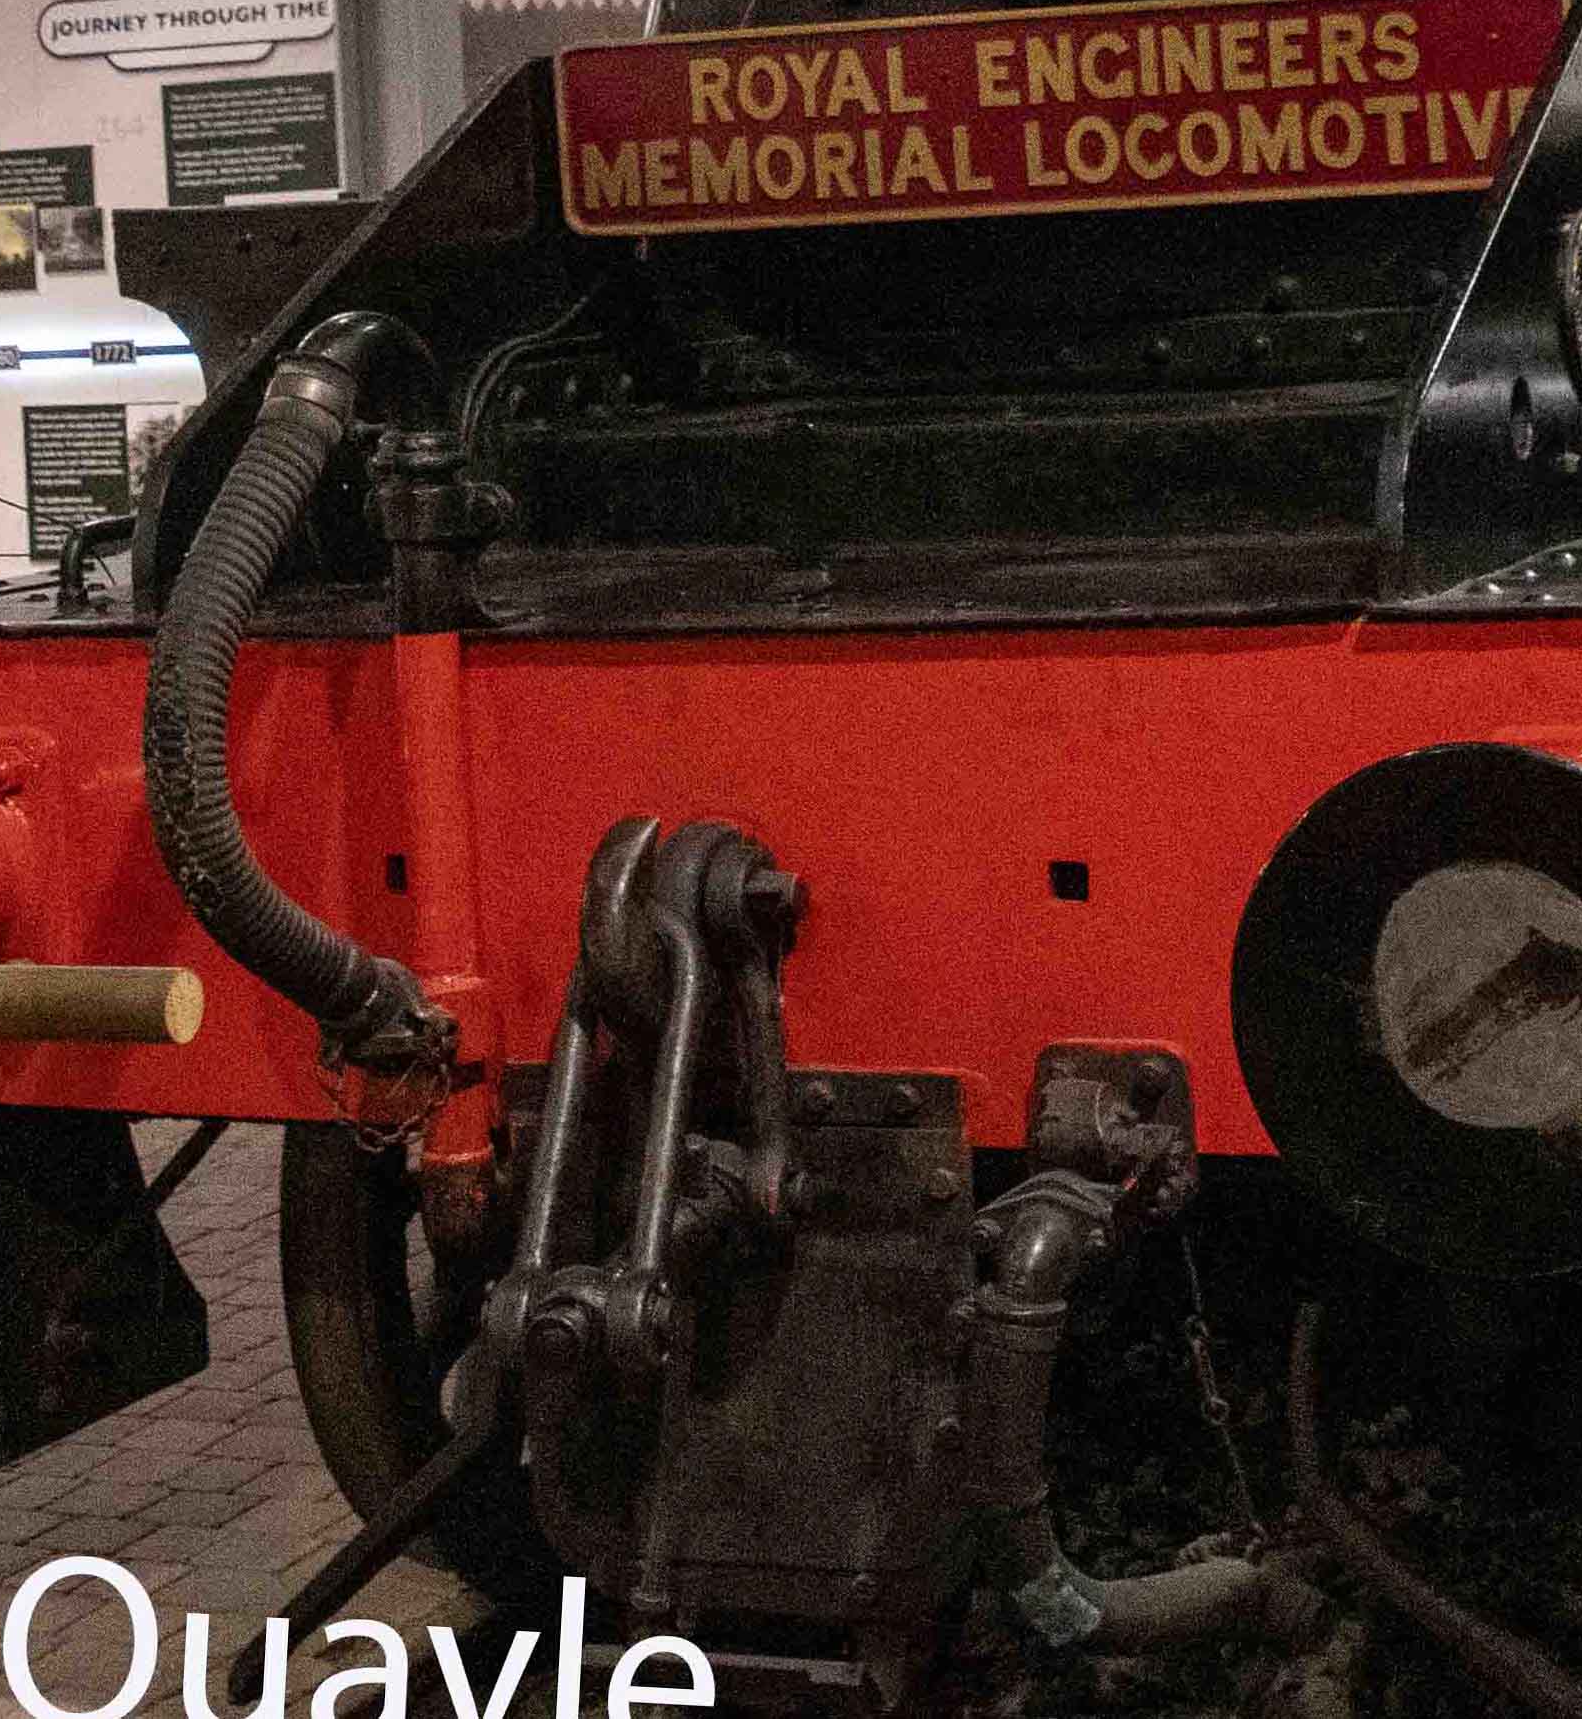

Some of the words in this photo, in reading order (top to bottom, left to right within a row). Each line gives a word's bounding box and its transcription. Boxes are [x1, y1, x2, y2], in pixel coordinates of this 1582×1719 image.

[51, 16, 148, 41] JOURNEY
[155, 4, 267, 30] THROUGH
[276, 0, 330, 21] TIME
[688, 49, 928, 126] ROYAL
[975, 11, 1421, 109] ENGINEERS
[581, 124, 995, 209] MEMORIAL
